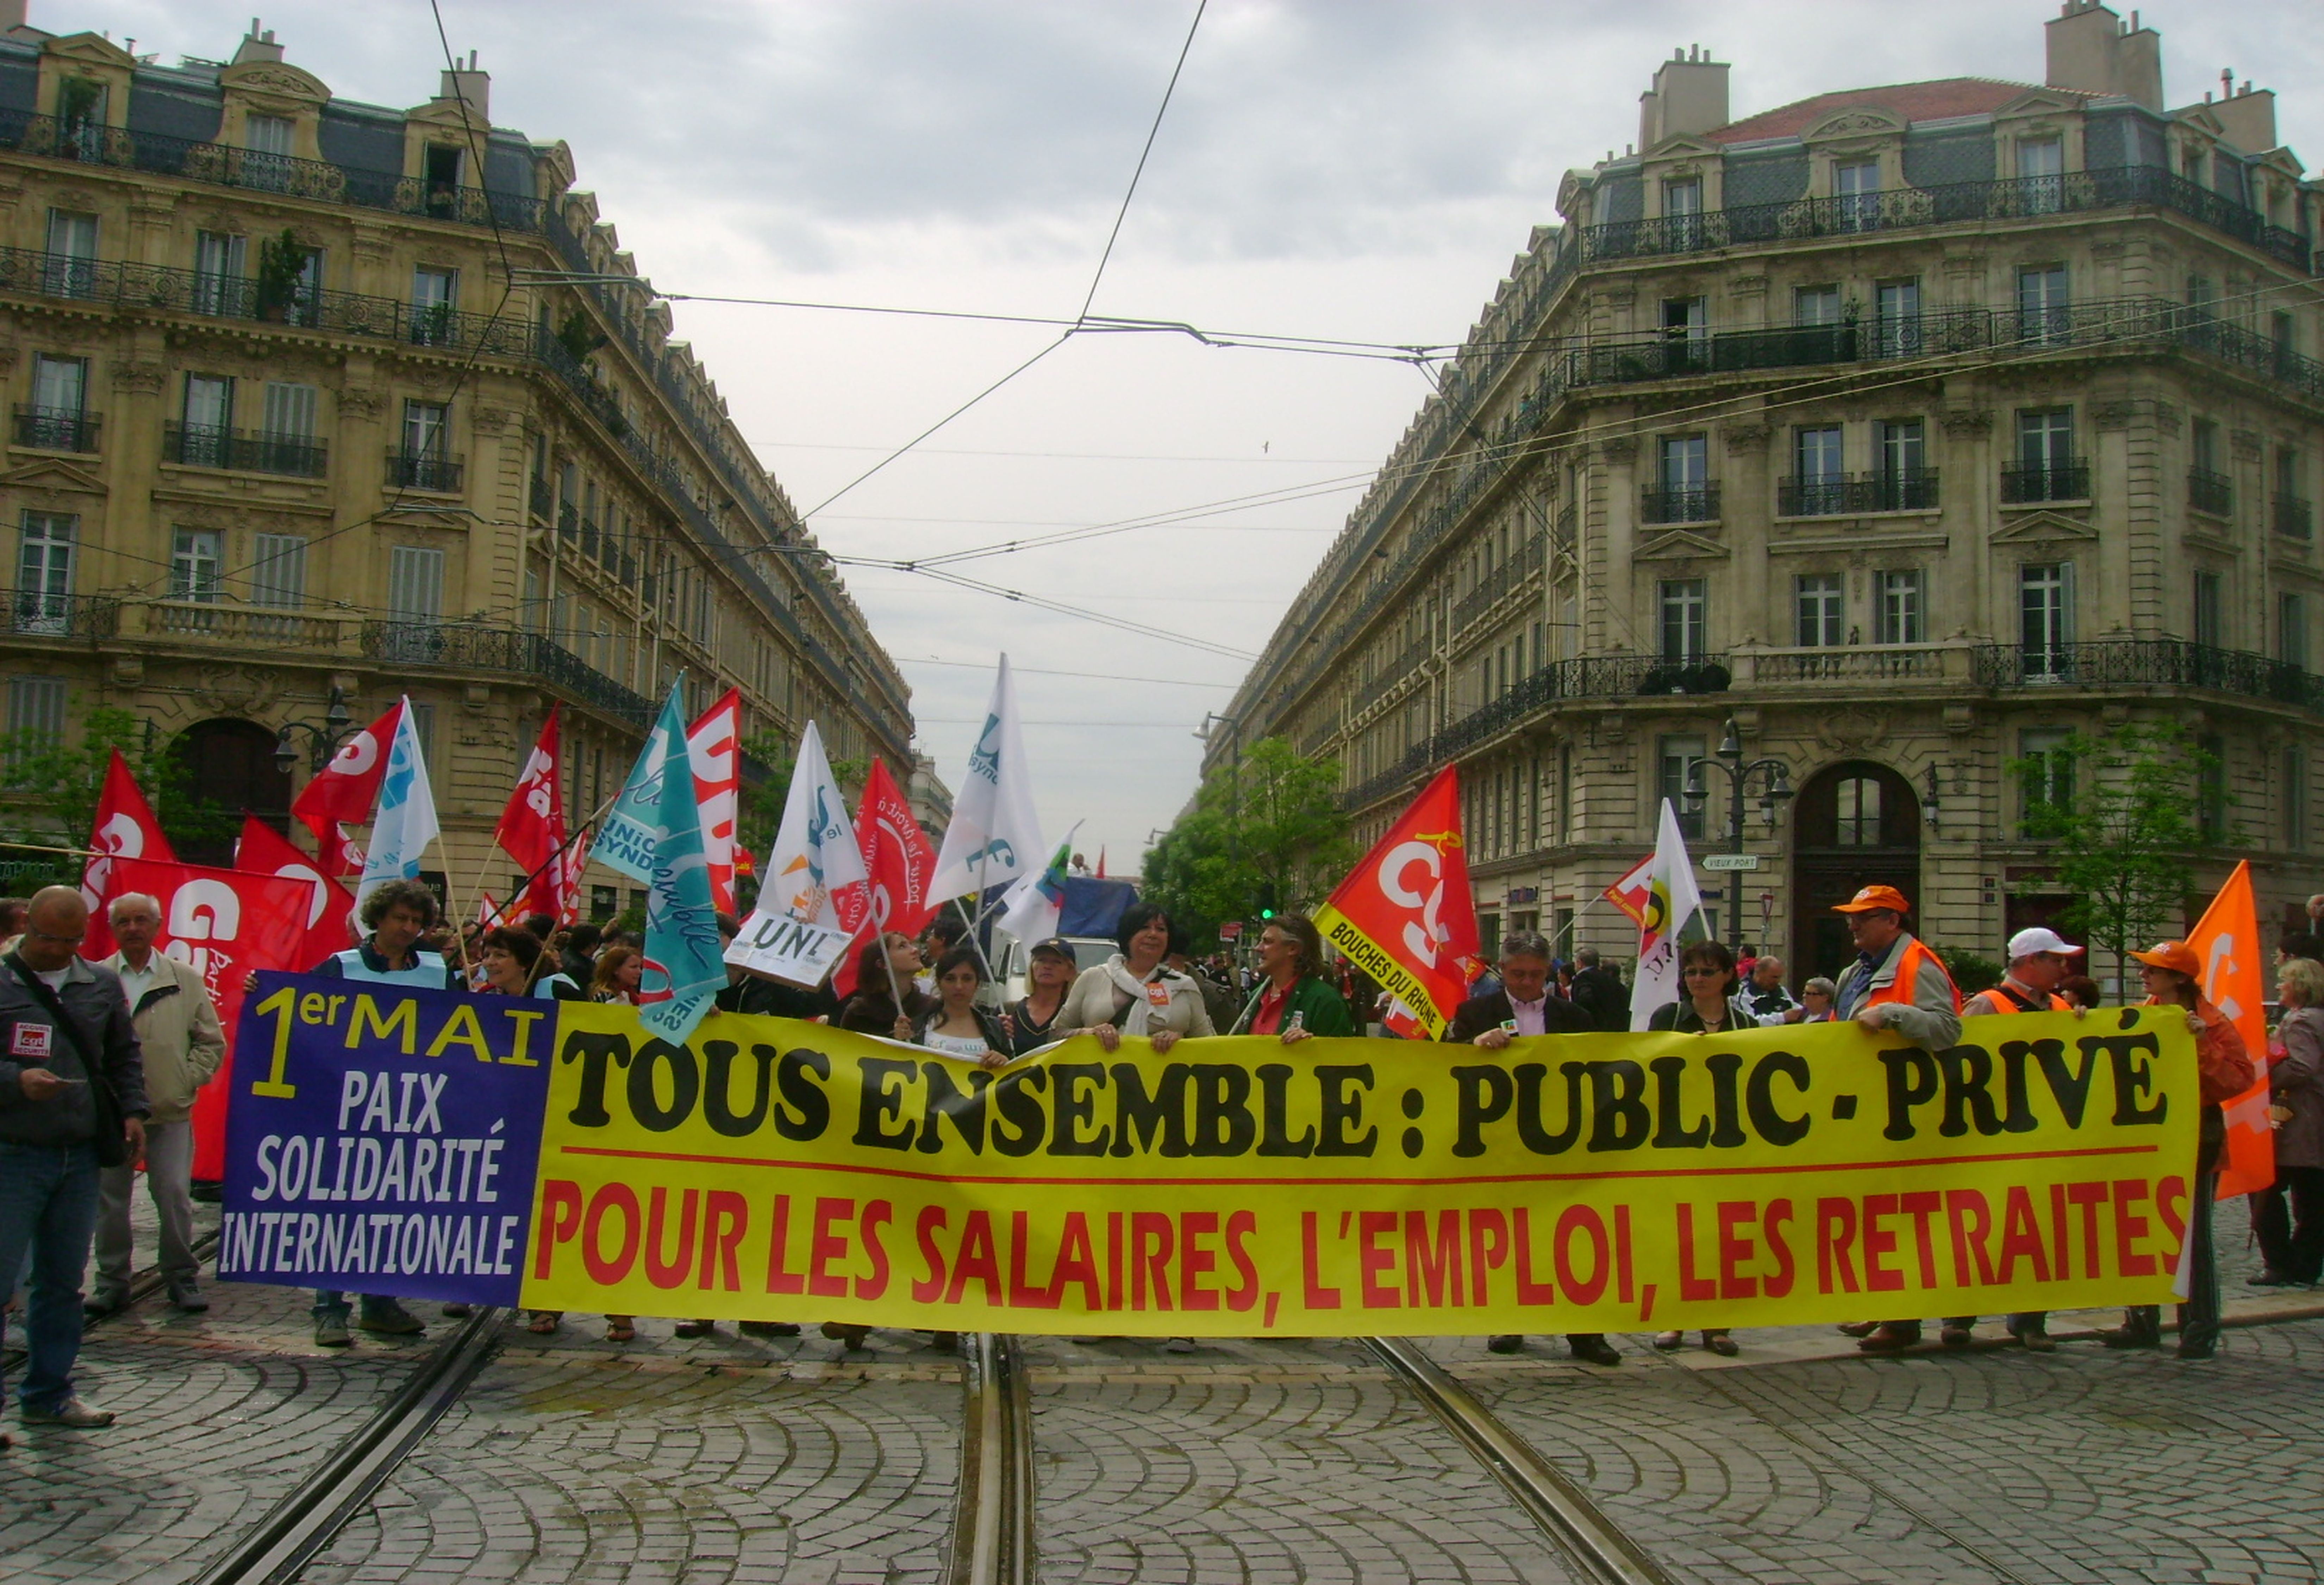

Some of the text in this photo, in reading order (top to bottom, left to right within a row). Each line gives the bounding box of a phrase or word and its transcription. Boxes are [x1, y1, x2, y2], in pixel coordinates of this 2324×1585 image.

[1710, 858, 1755, 867] VIEUX PORT
[1330, 922, 1392, 978] BOUCHES
[1386, 970, 1412, 994] DU
[251, 987, 545, 1099] 1er MAI
[337, 1070, 448, 1135] PAIX
[561, 1029, 831, 1142] TOUS
[851, 1055, 1378, 1159] ENSEMBLE
[1449, 1051, 1811, 1158] PUBLIC
[1878, 1008, 2168, 1142] PRIVÉ
[251, 1117, 505, 1203] SOLIDARITÉ
[220, 1212, 519, 1275] INTERNATIONALE
[534, 1175, 2187, 1328] POUR LES SALAIRES, L'EMPLOI, LES RETRAITES
